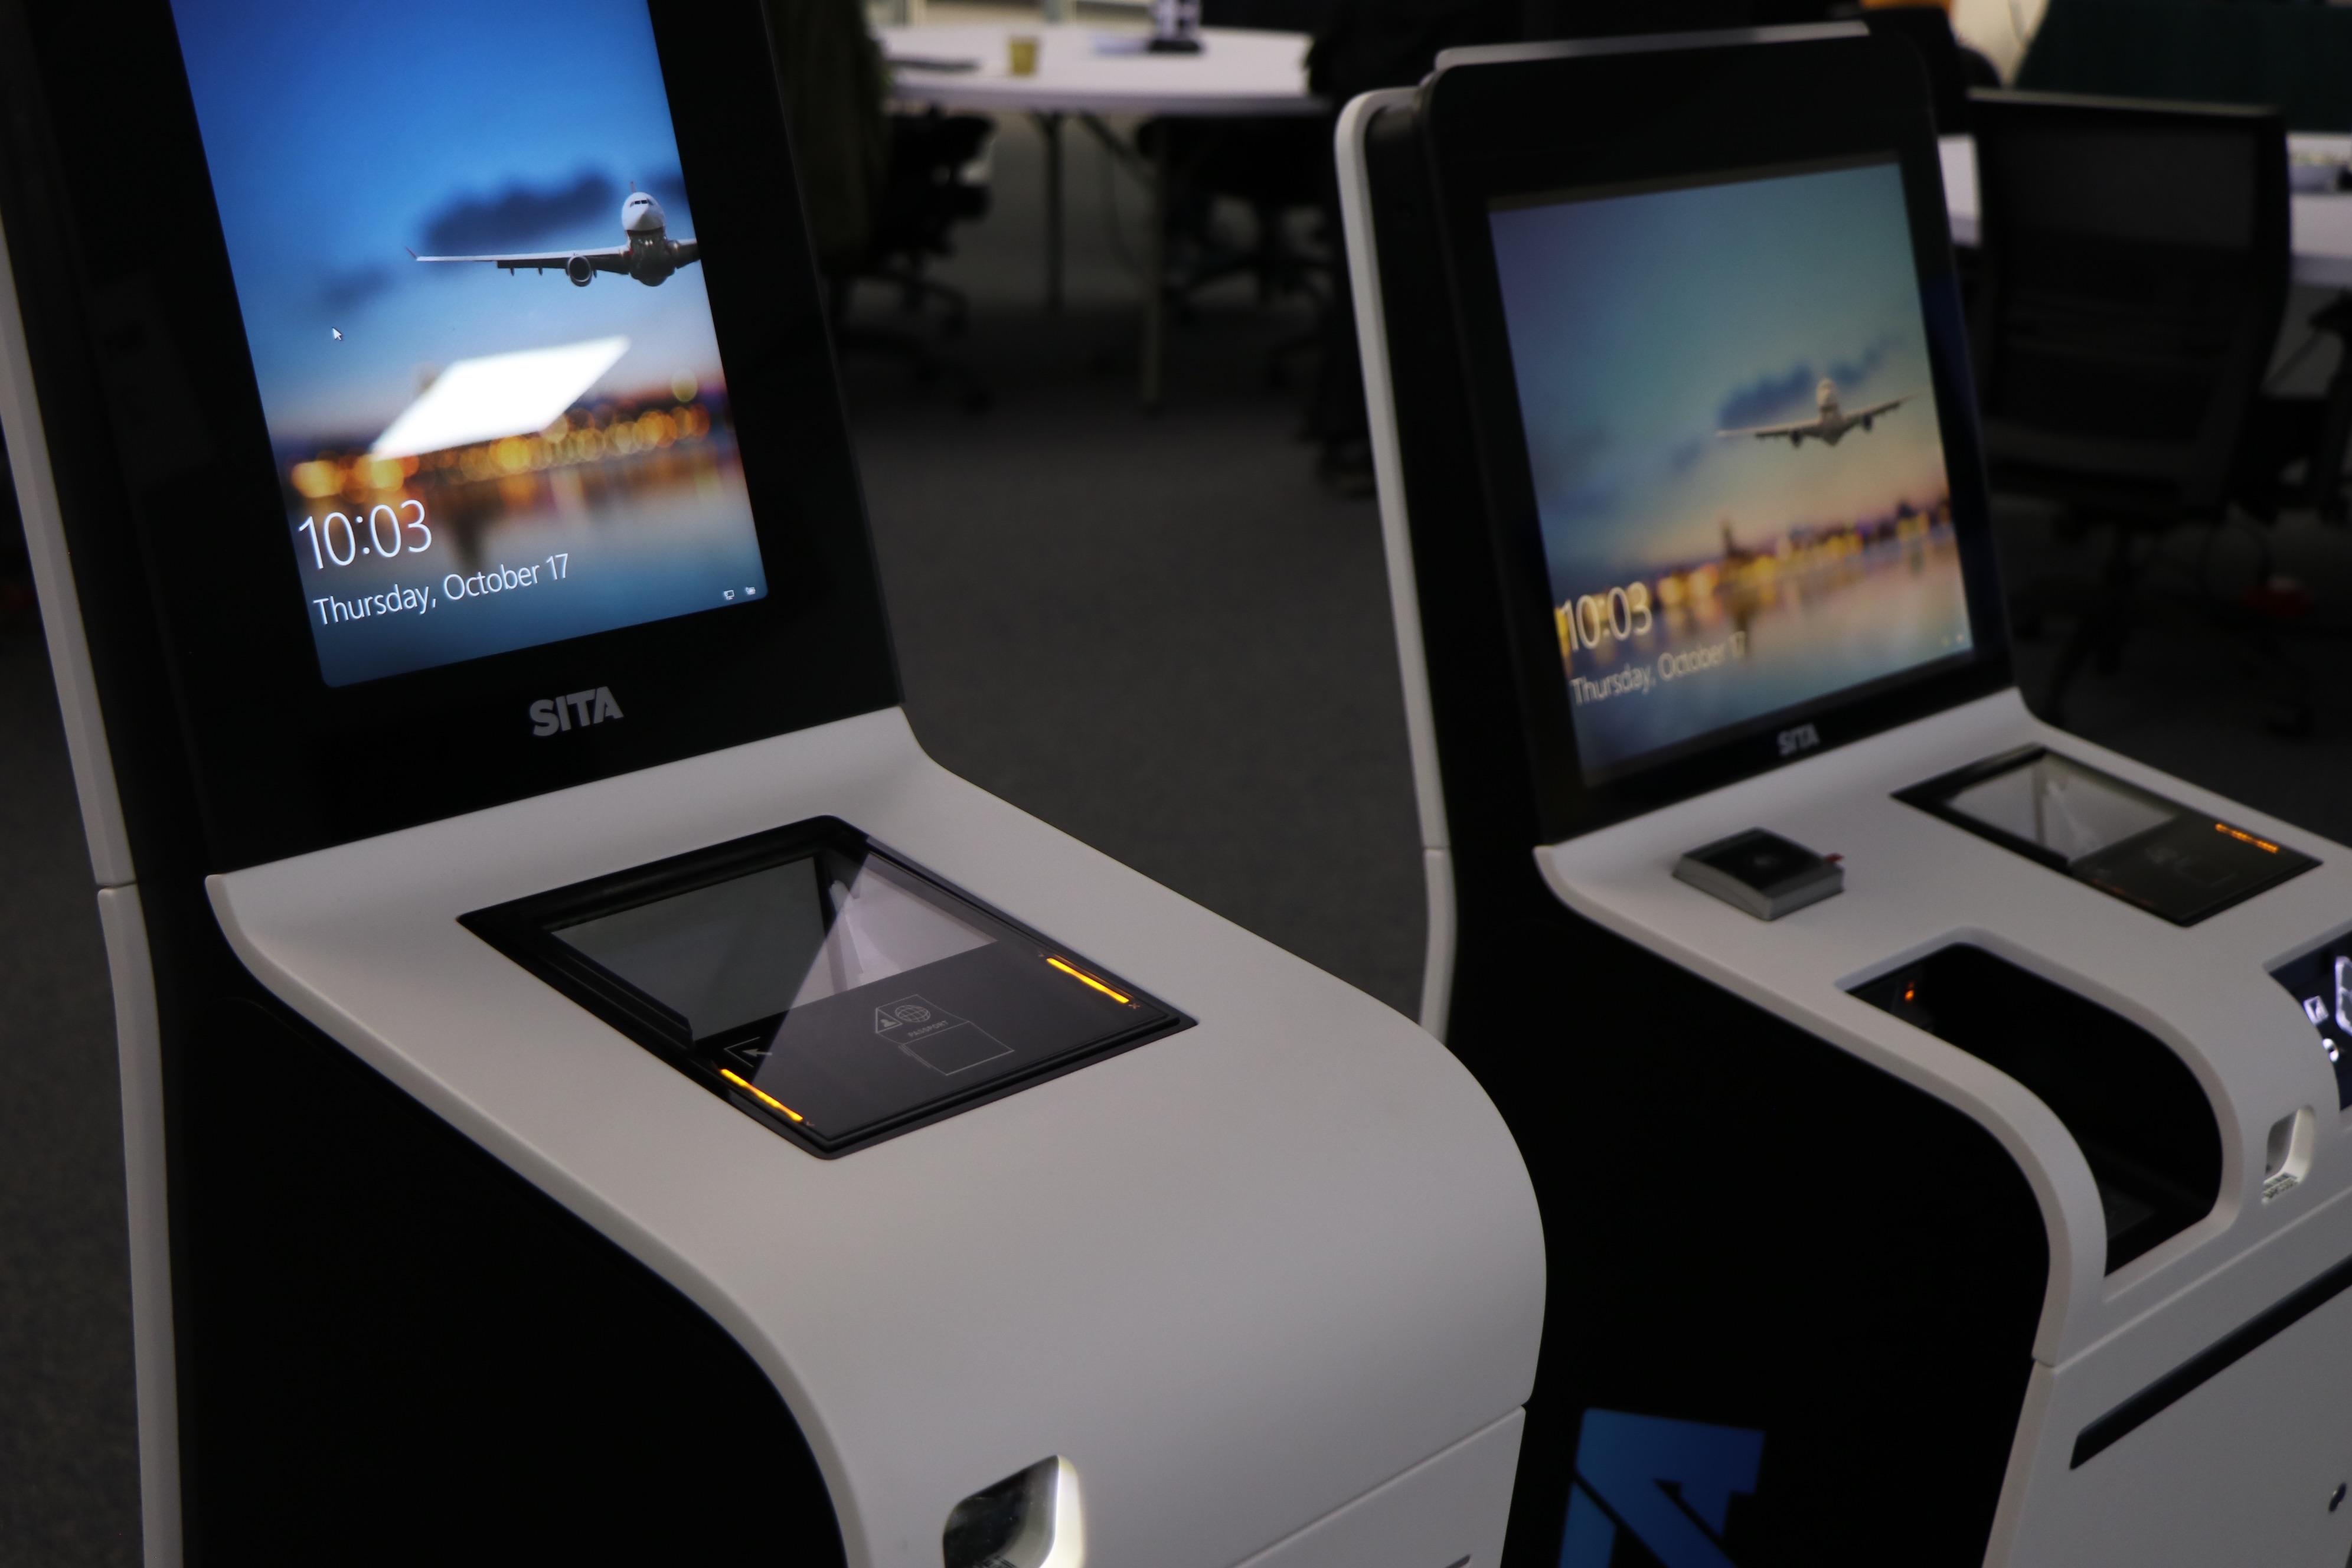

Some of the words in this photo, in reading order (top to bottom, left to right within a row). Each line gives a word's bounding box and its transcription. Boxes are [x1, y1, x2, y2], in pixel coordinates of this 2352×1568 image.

[299, 499, 432, 569] 10:03
[313, 583, 436, 624] Thursday,
[444, 564, 540, 600] October
[546, 553, 569, 580] 17
[1562, 581, 1653, 652] 10:03
[1570, 664, 1657, 705] Thursday,
[1658, 642, 1726, 682] October
[530, 686, 623, 736] SITA
[1778, 724, 1819, 755] SITA
